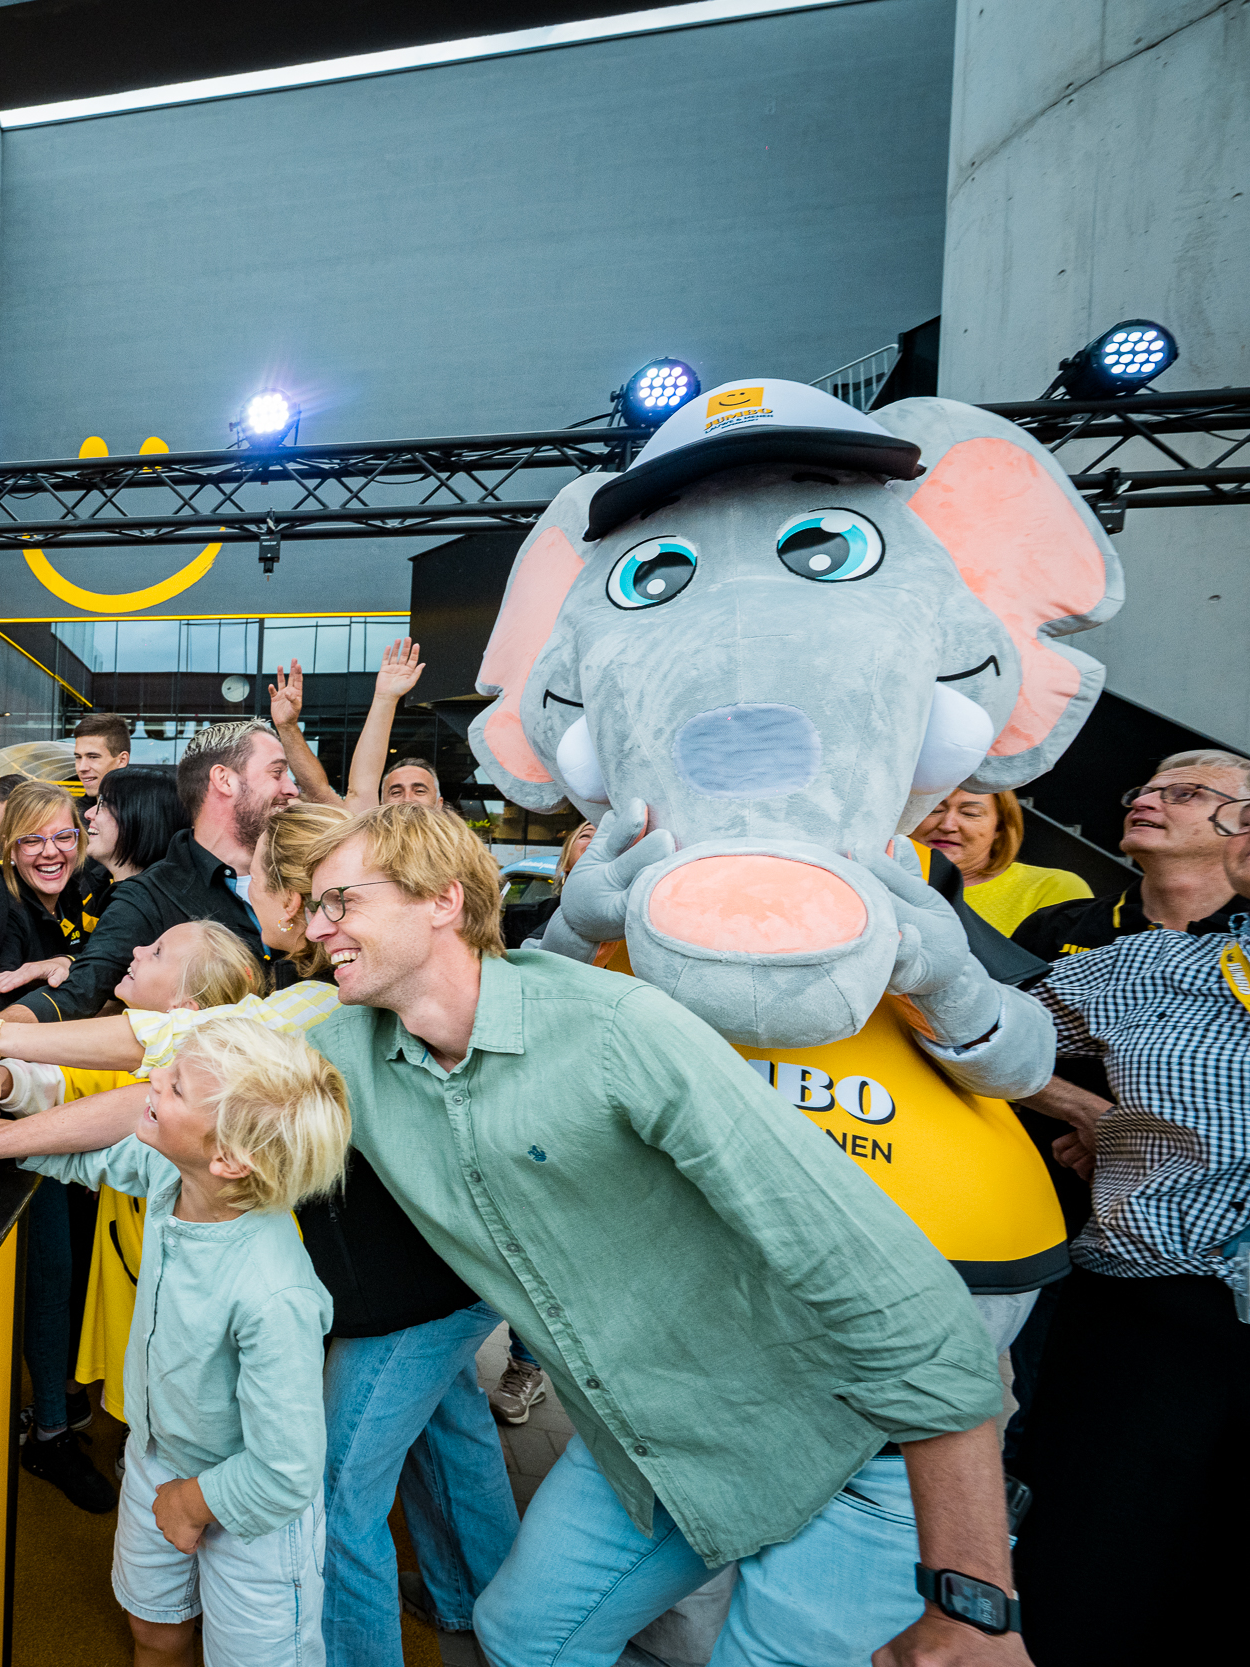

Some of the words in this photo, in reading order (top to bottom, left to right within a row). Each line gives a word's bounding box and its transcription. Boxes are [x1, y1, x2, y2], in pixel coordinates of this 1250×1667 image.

[704, 408, 773, 431] JUMBO
[1226, 962, 1250, 995] JUMBO
[748, 1058, 896, 1126] BO
[820, 1127, 893, 1165] NEN
